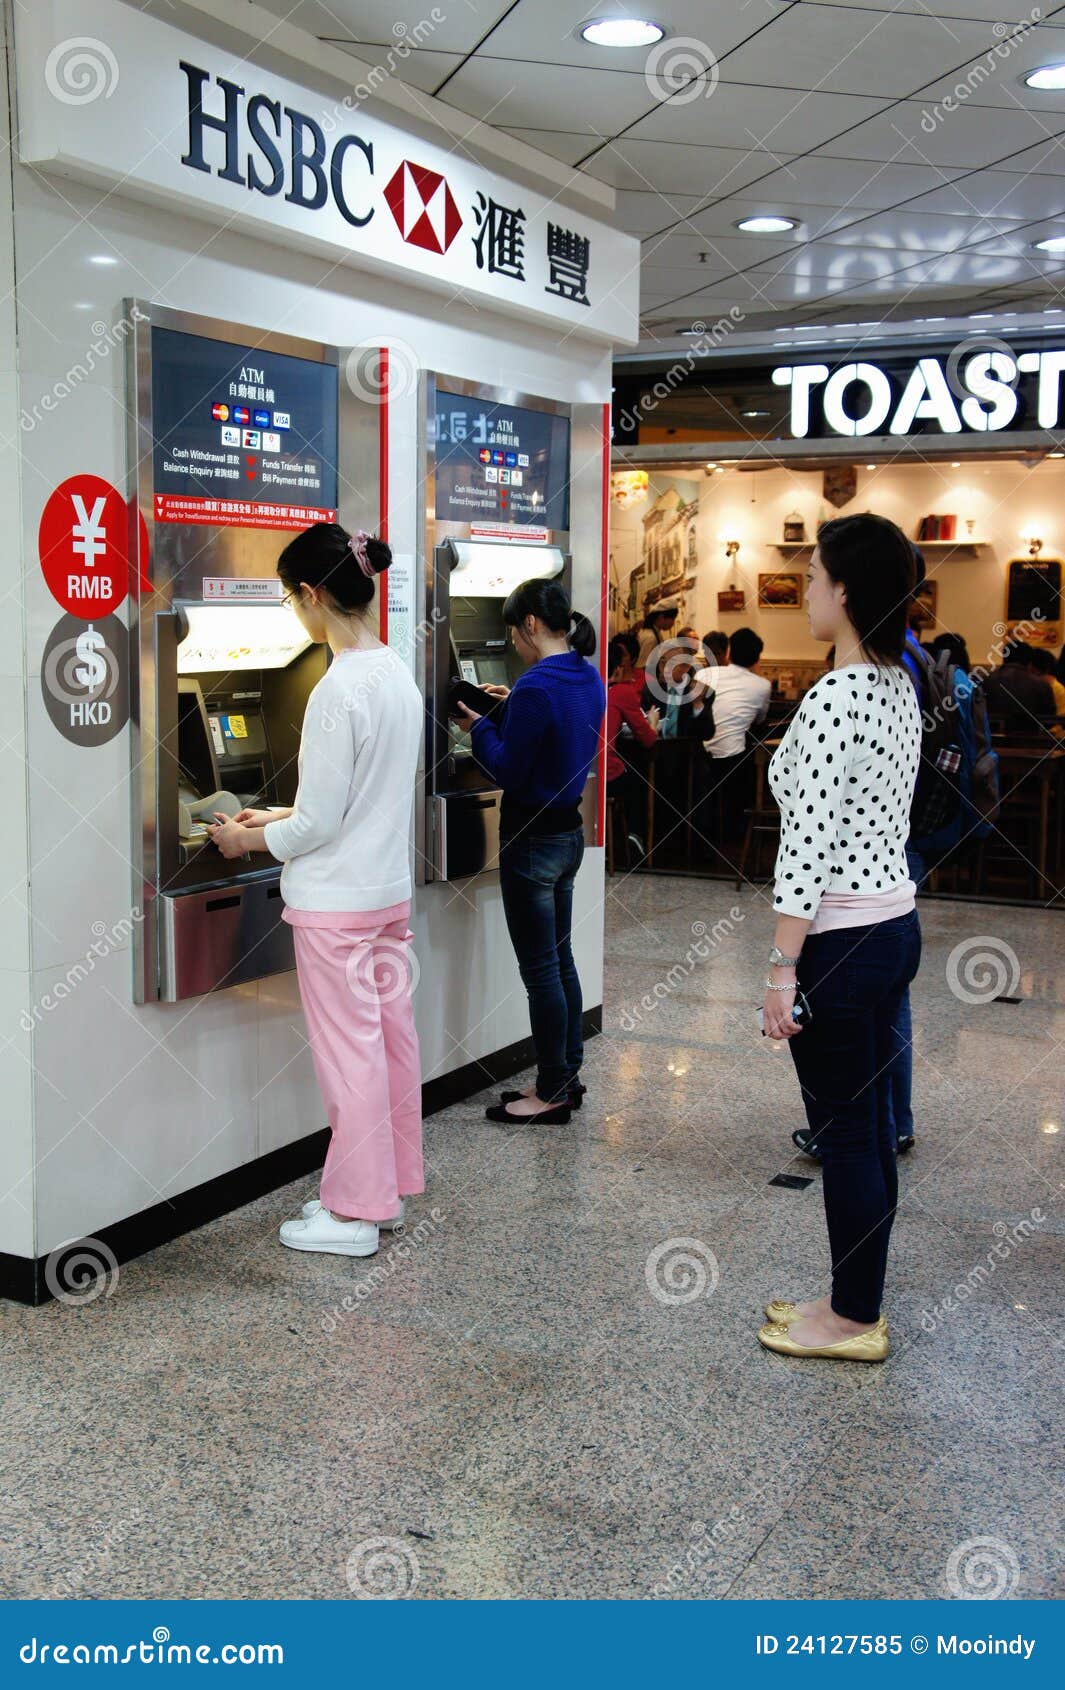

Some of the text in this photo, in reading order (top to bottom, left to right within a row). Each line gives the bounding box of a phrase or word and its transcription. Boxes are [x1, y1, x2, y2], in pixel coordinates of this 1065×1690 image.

[179, 61, 375, 228] HSBC
[239, 367, 265, 385] ATM
[229, 381, 275, 403] 自動櫃員機
[772, 351, 1065, 437] TOAST
[275, 415, 289, 425] VISA
[497, 420, 513, 433] ATM
[172, 447, 190, 459] Cash
[190, 449, 226, 463] Withdrawal
[163, 461, 189, 474] Balance
[190, 464, 213, 478] Enquiry
[262, 459, 280, 470] Funds
[281, 461, 303, 473] Transfer
[262, 472, 272, 483] Bill
[272, 473, 297, 486] Payment
[67, 575, 112, 600] RMB
[70, 702, 112, 727] HKD
